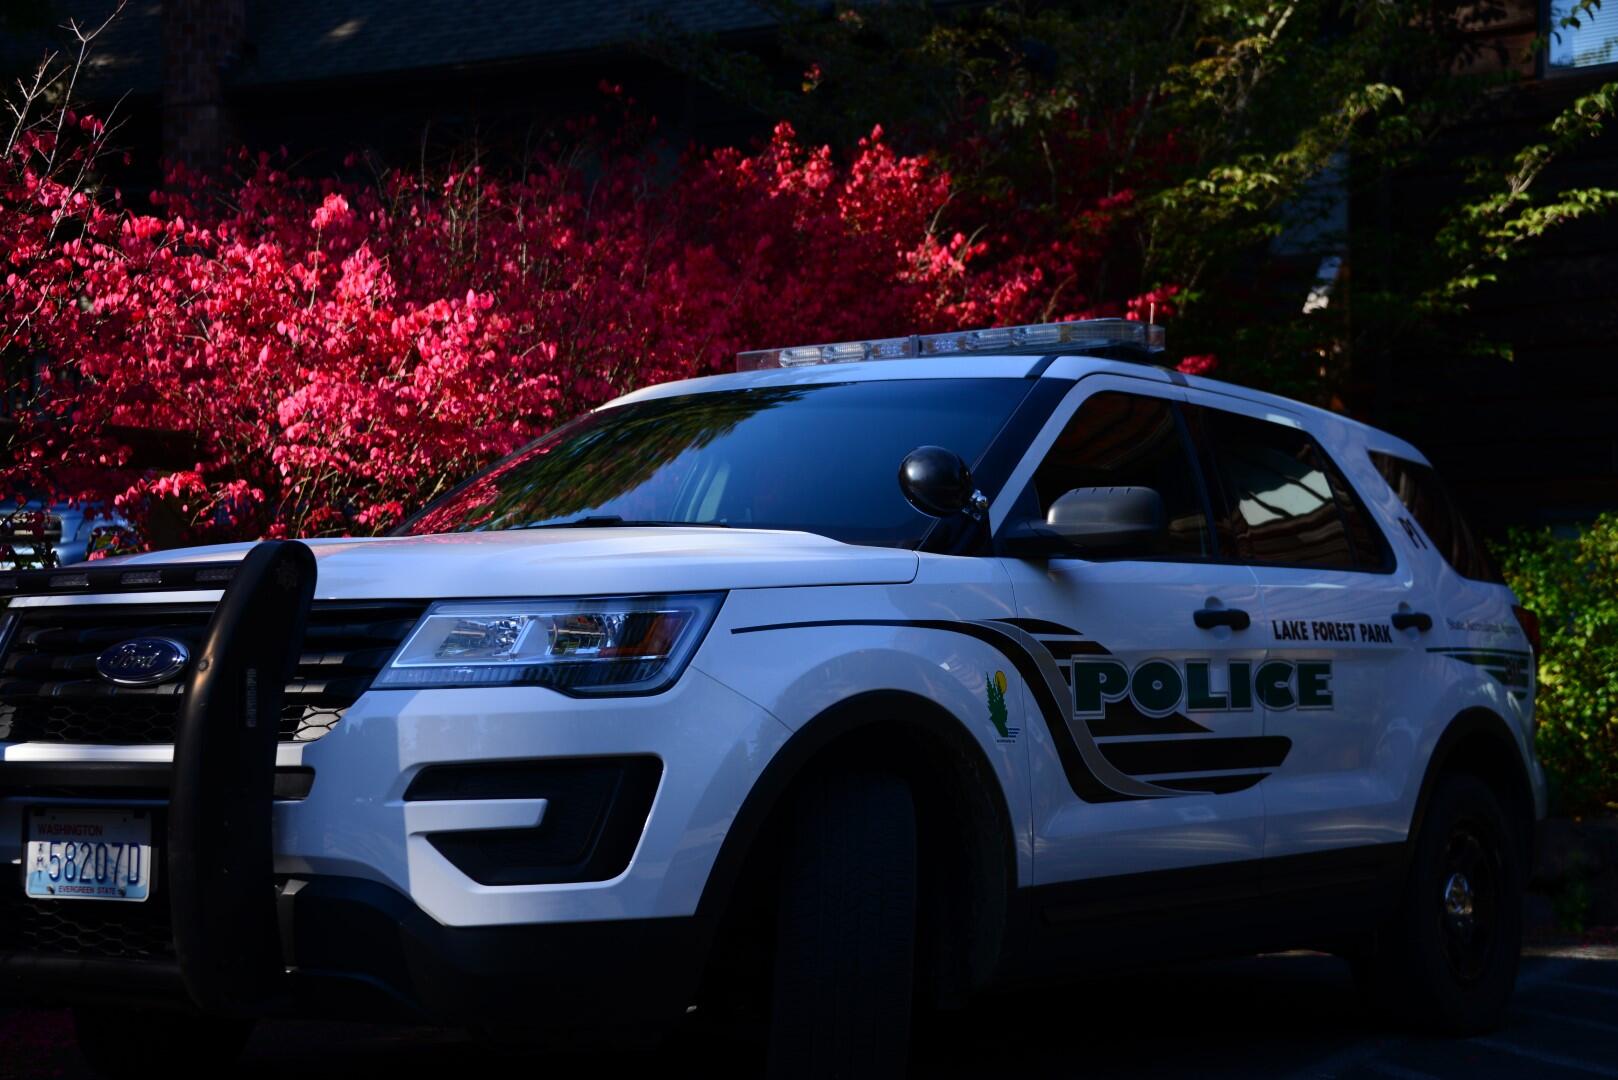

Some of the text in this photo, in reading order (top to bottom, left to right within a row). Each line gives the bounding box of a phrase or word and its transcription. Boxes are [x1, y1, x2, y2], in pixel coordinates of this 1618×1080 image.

[1273, 619, 1393, 643] LAKE FOREST PARK
[108, 643, 163, 672] Ford
[1072, 656, 1333, 719] POLICE
[38, 823, 103, 837] WASHINGTON
[49, 840, 140, 885] 58207D
[58, 885, 95, 894] EVERGREEN
